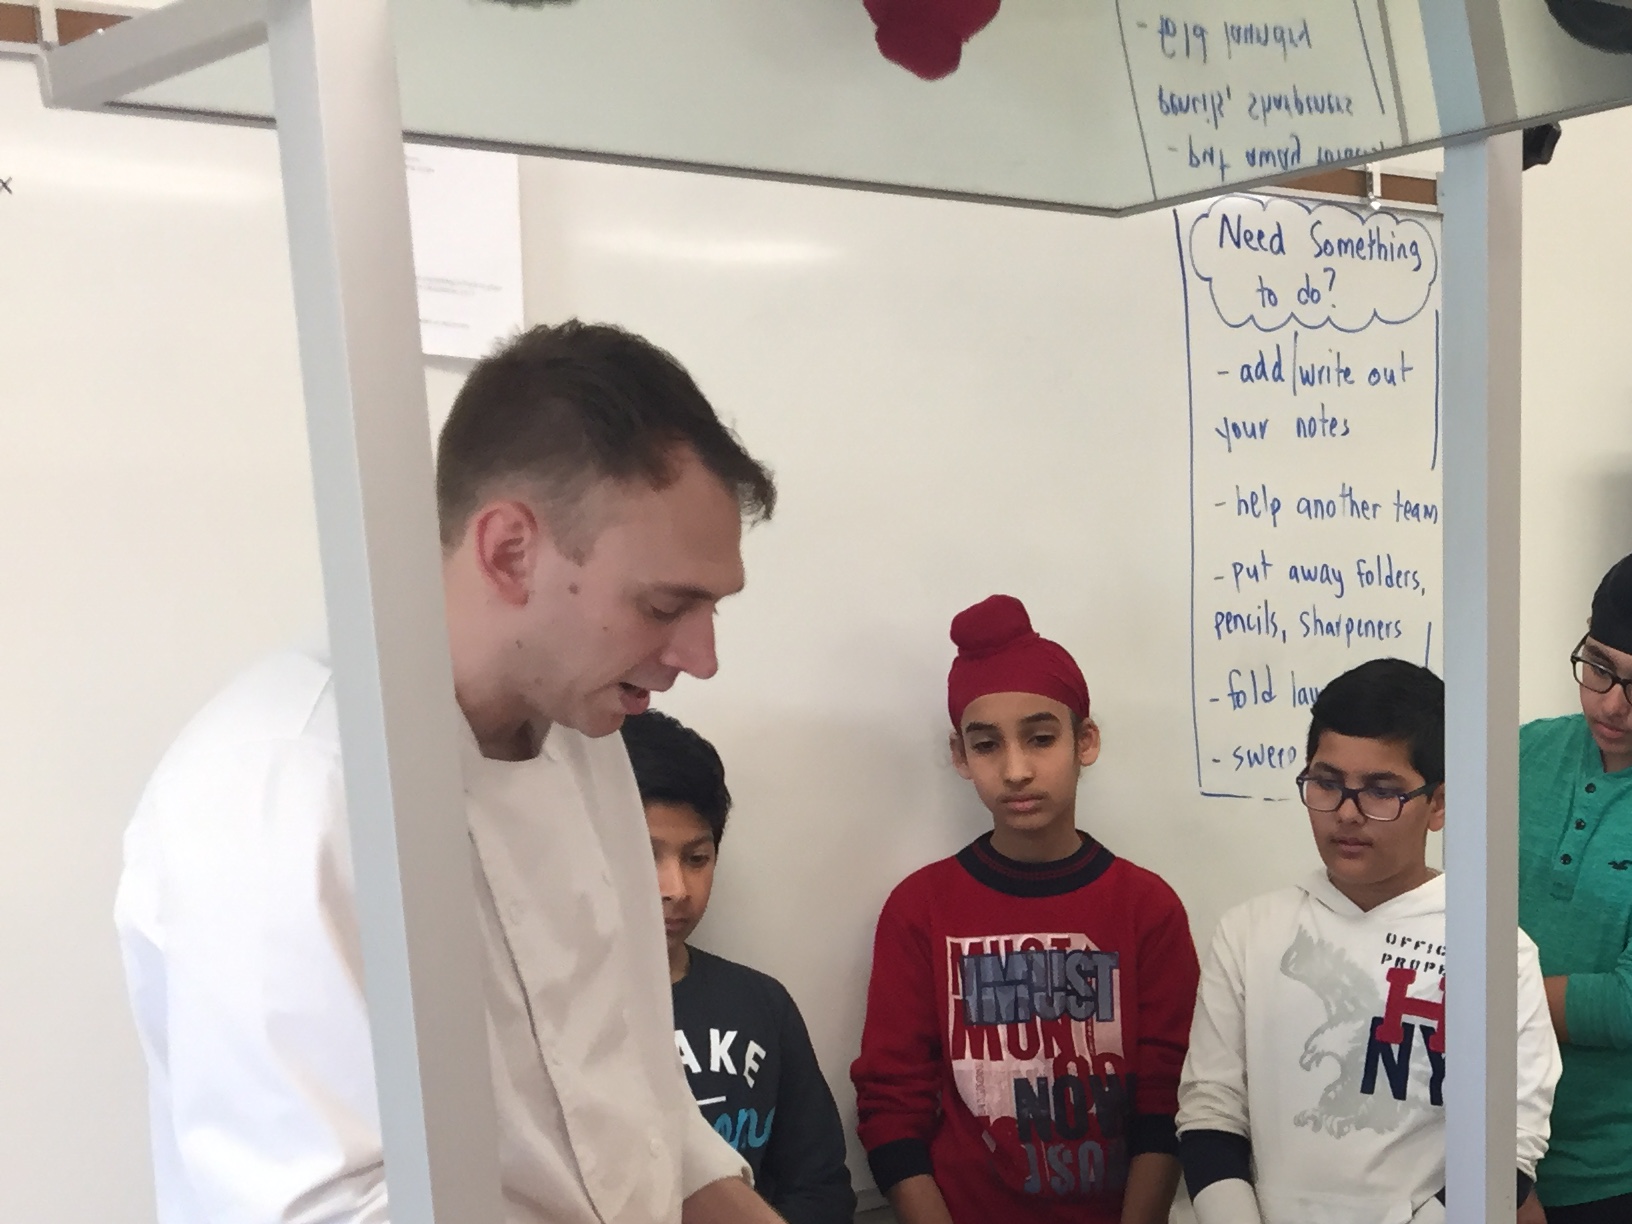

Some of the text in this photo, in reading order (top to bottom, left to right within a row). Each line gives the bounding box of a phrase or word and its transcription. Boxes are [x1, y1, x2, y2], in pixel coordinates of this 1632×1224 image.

[1218, 213, 1286, 256] Need
[1256, 266, 1337, 308] to do?
[1368, 350, 1414, 387] out
[1215, 402, 1350, 453] your notes
[1236, 482, 1438, 528] help another team
[1232, 549, 1426, 598] put away folders,
[1214, 599, 1287, 644] pencils,
[1228, 664, 1277, 711] fold
